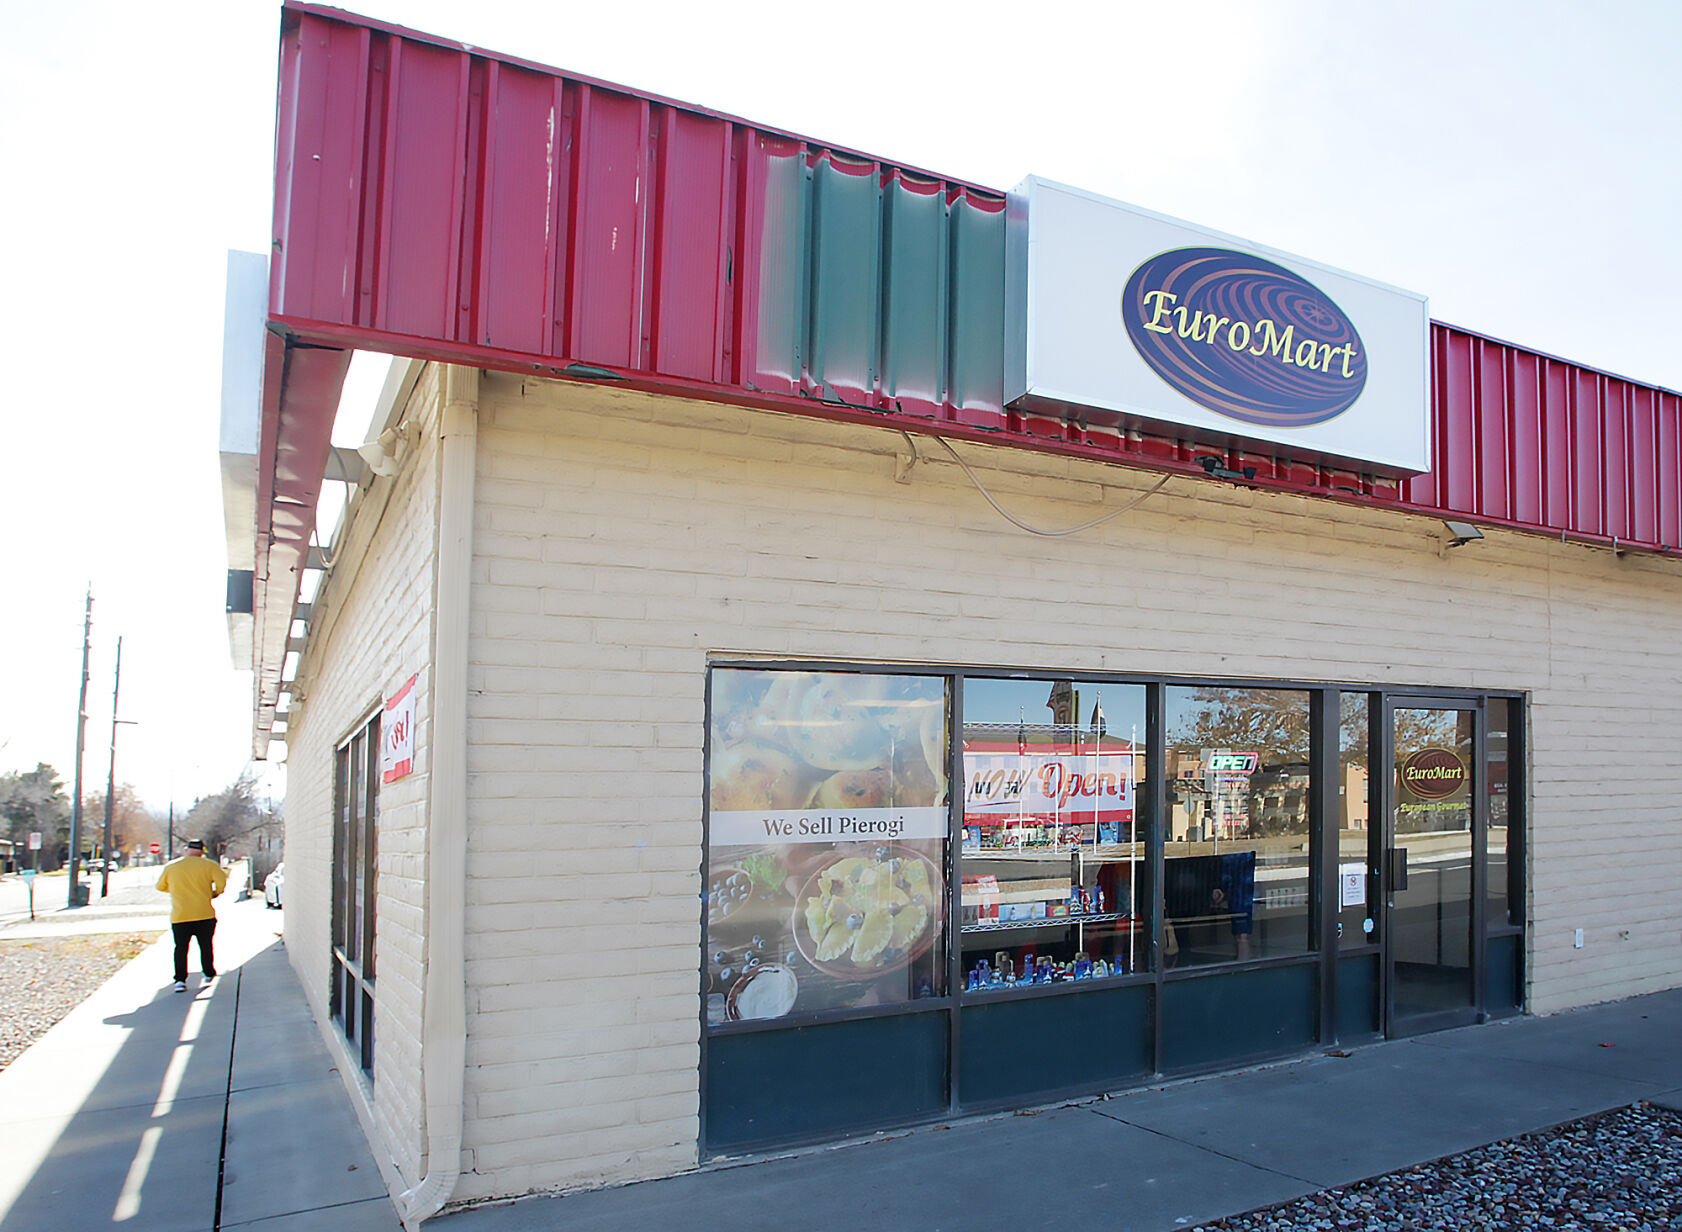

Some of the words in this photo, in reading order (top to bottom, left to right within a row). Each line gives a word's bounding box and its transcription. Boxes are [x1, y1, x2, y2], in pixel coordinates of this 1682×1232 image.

[1143, 290, 1357, 378] EuroMart
[1208, 755, 1255, 771] OPEN
[1406, 766, 1462, 780] EuroMart
[1038, 762, 1127, 809] Open!
[762, 818, 793, 836] We
[798, 817, 833, 835] Sell
[839, 815, 905, 838] Pierogi
